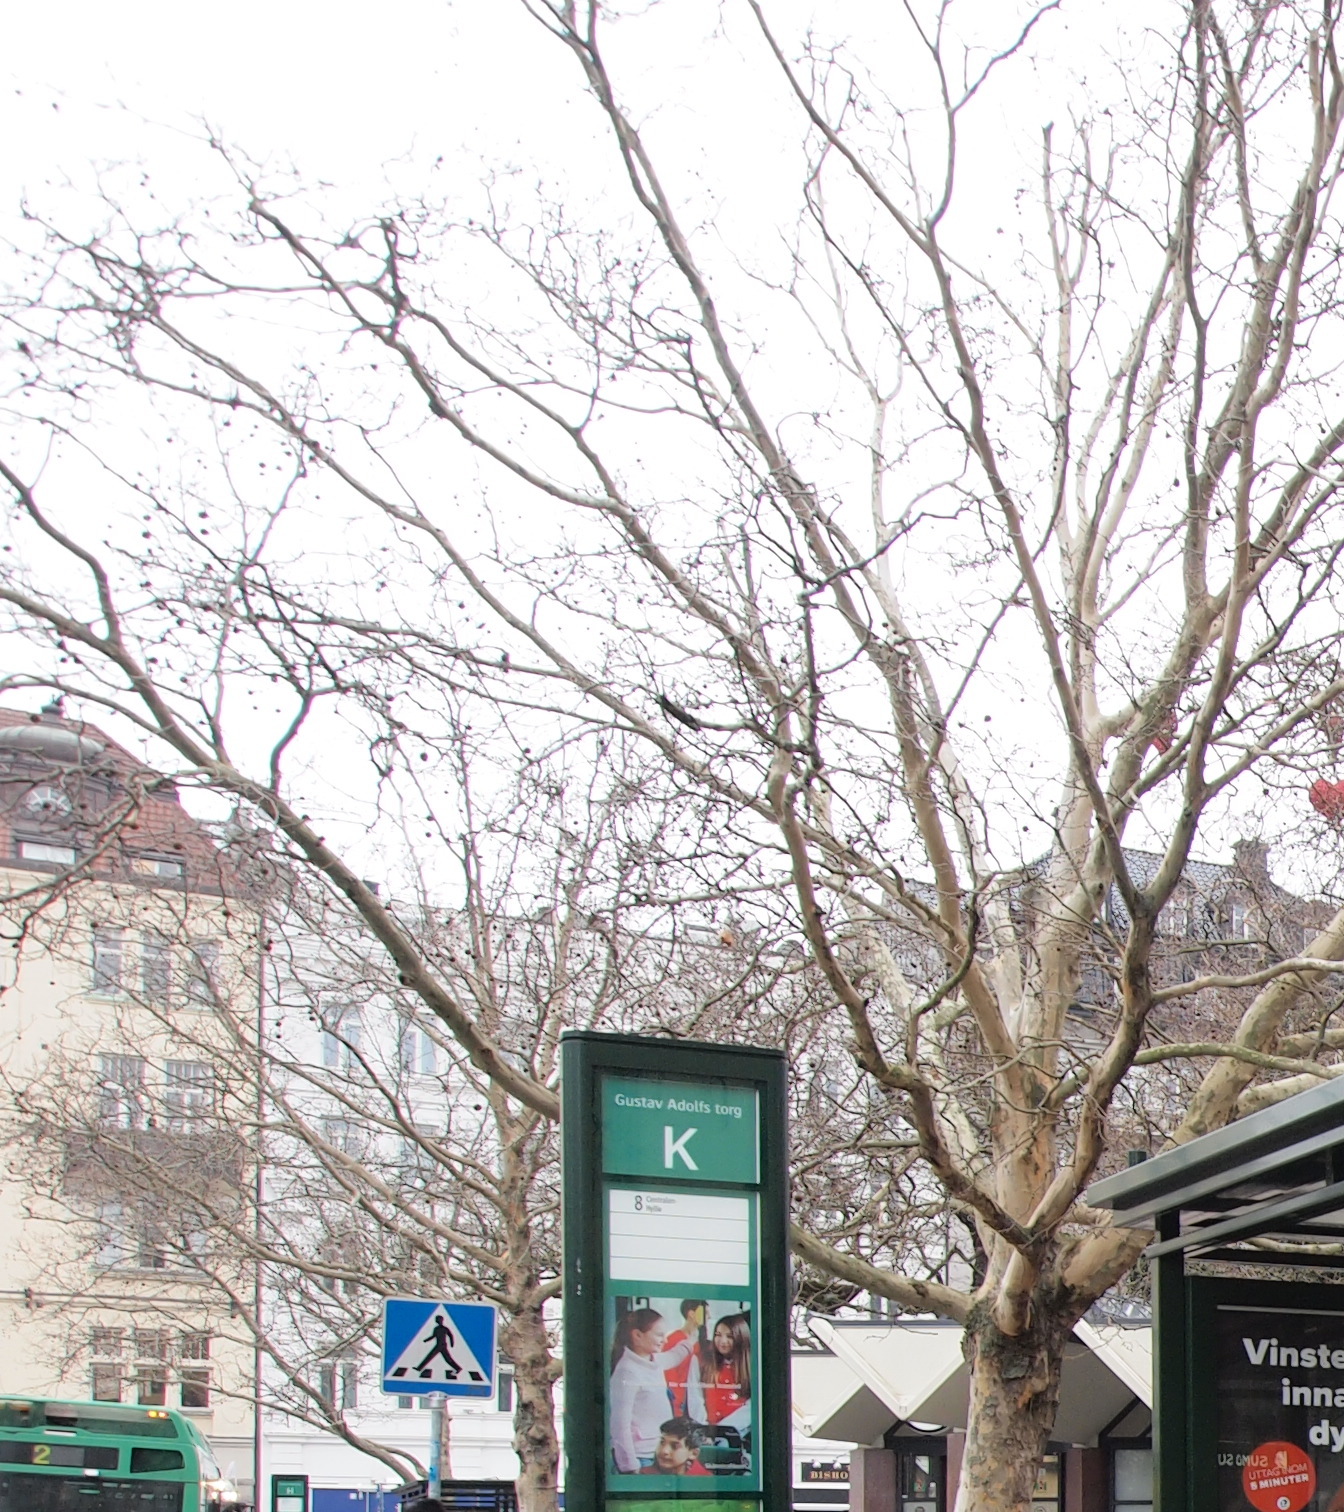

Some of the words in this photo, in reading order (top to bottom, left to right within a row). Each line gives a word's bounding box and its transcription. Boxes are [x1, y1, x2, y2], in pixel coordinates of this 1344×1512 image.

[615, 1093, 663, 1110] Gustav
[667, 1098, 711, 1114] Adolfs
[715, 1102, 742, 1118] torg
[664, 1125, 699, 1171] K
[634, 1195, 643, 1211] 8
[33, 1444, 51, 1465] 2
[1248, 1467, 1280, 1480] UTTAG
[1282, 1463, 1307, 1475] INOM
[1259, 1473, 1309, 1489] MINUTER
[286, 1486, 294, 1495] H
